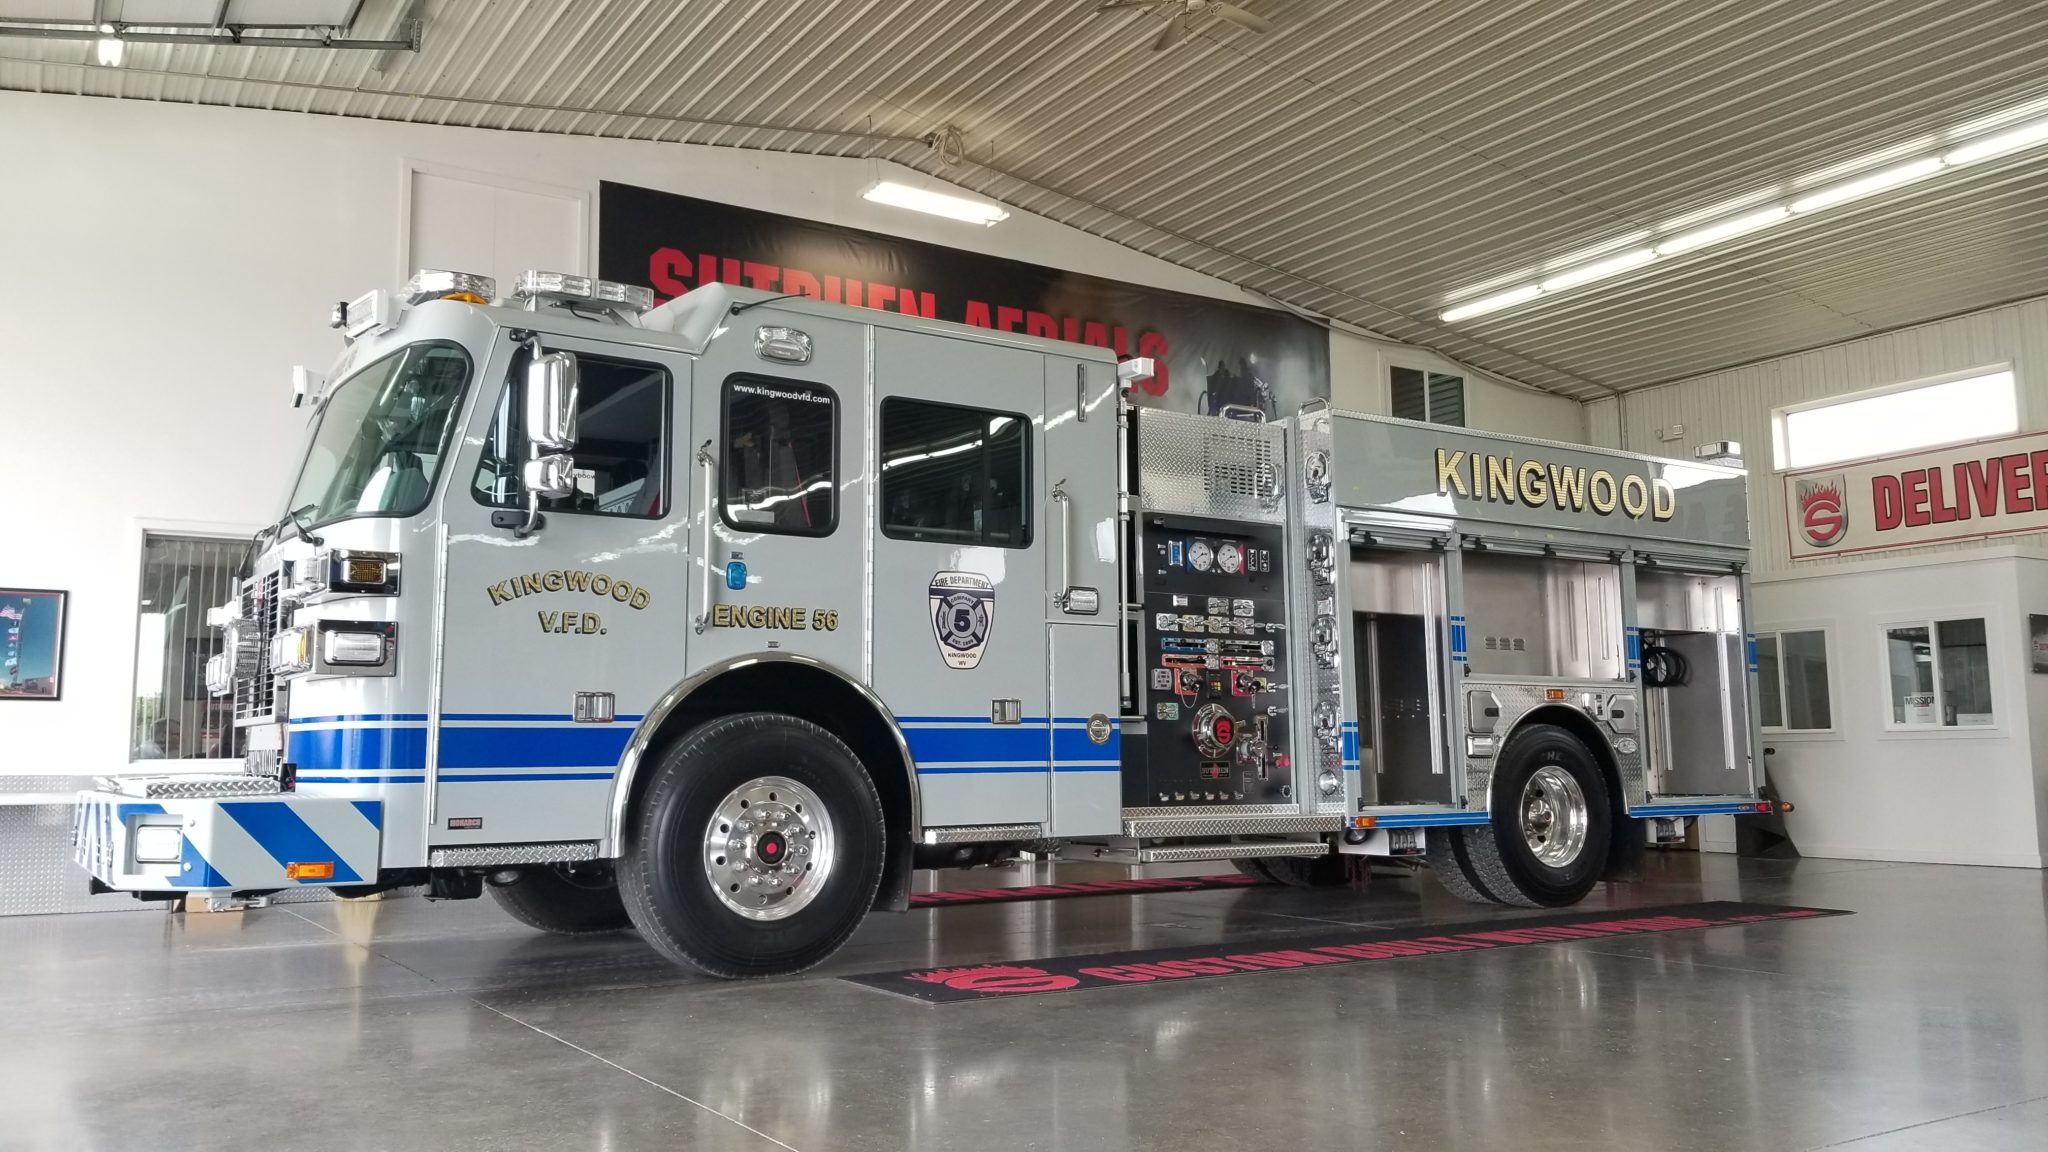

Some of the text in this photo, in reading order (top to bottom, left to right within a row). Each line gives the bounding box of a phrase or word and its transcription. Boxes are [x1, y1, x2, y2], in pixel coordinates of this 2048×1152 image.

[733, 384, 830, 404] www.kingwoodvfd.com
[1435, 447, 1676, 522] KINGWOOD
[486, 570, 651, 610] KINGWOOD
[935, 576, 989, 589] FIRE DEPARTMENT
[538, 610, 608, 635] V.F.D.
[713, 604, 839, 631] ENGINE 56
[953, 608, 971, 633] 5
[1078, 949, 1353, 982] CUSTOM
